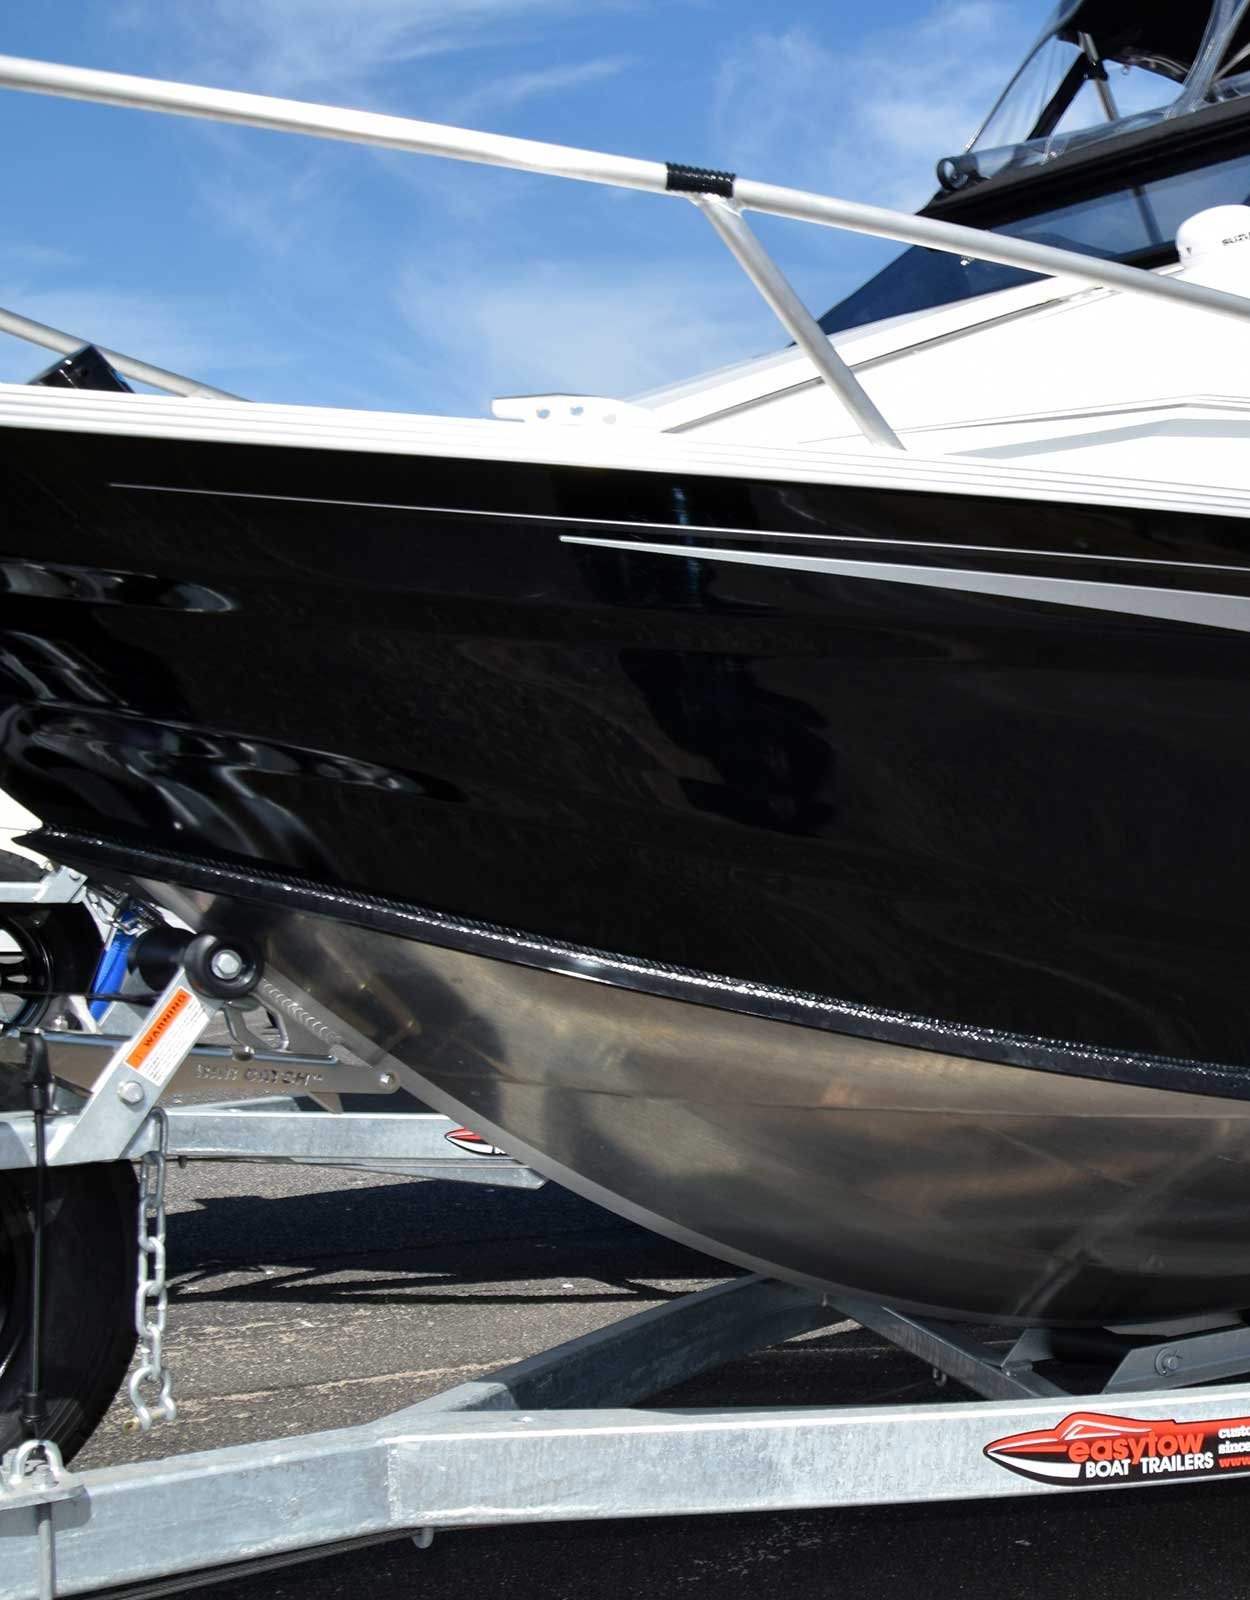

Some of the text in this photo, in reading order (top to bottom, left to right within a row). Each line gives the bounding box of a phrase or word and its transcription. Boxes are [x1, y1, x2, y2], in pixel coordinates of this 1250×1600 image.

[143, 994, 187, 1047] WARNING
[1068, 1431, 1204, 1465] easytow
[1085, 1452, 1215, 1478] BOAT TRAILERS
